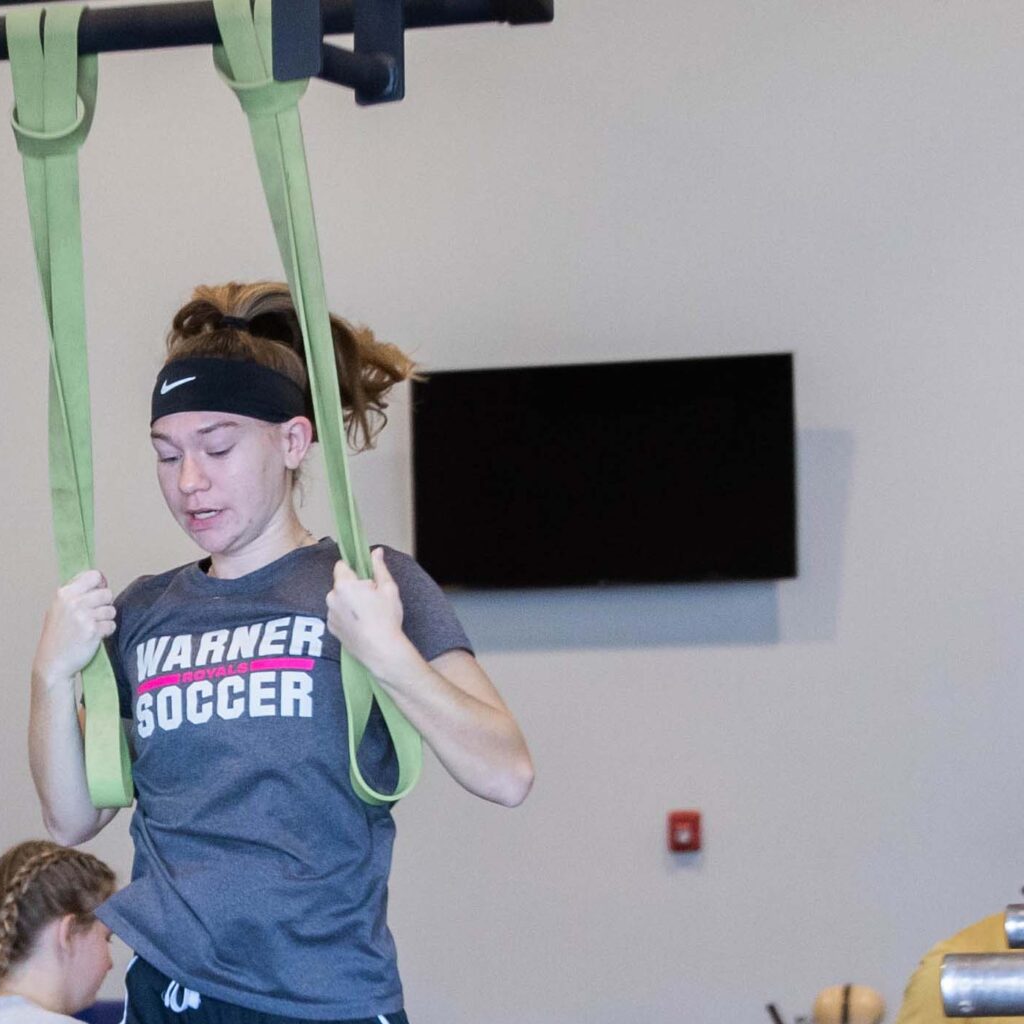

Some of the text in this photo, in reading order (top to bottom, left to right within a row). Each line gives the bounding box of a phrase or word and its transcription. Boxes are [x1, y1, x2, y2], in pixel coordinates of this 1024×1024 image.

[136, 616, 326, 682] WARNER
[182, 662, 250, 683] ROYALS
[136, 671, 314, 738] SOCCER
